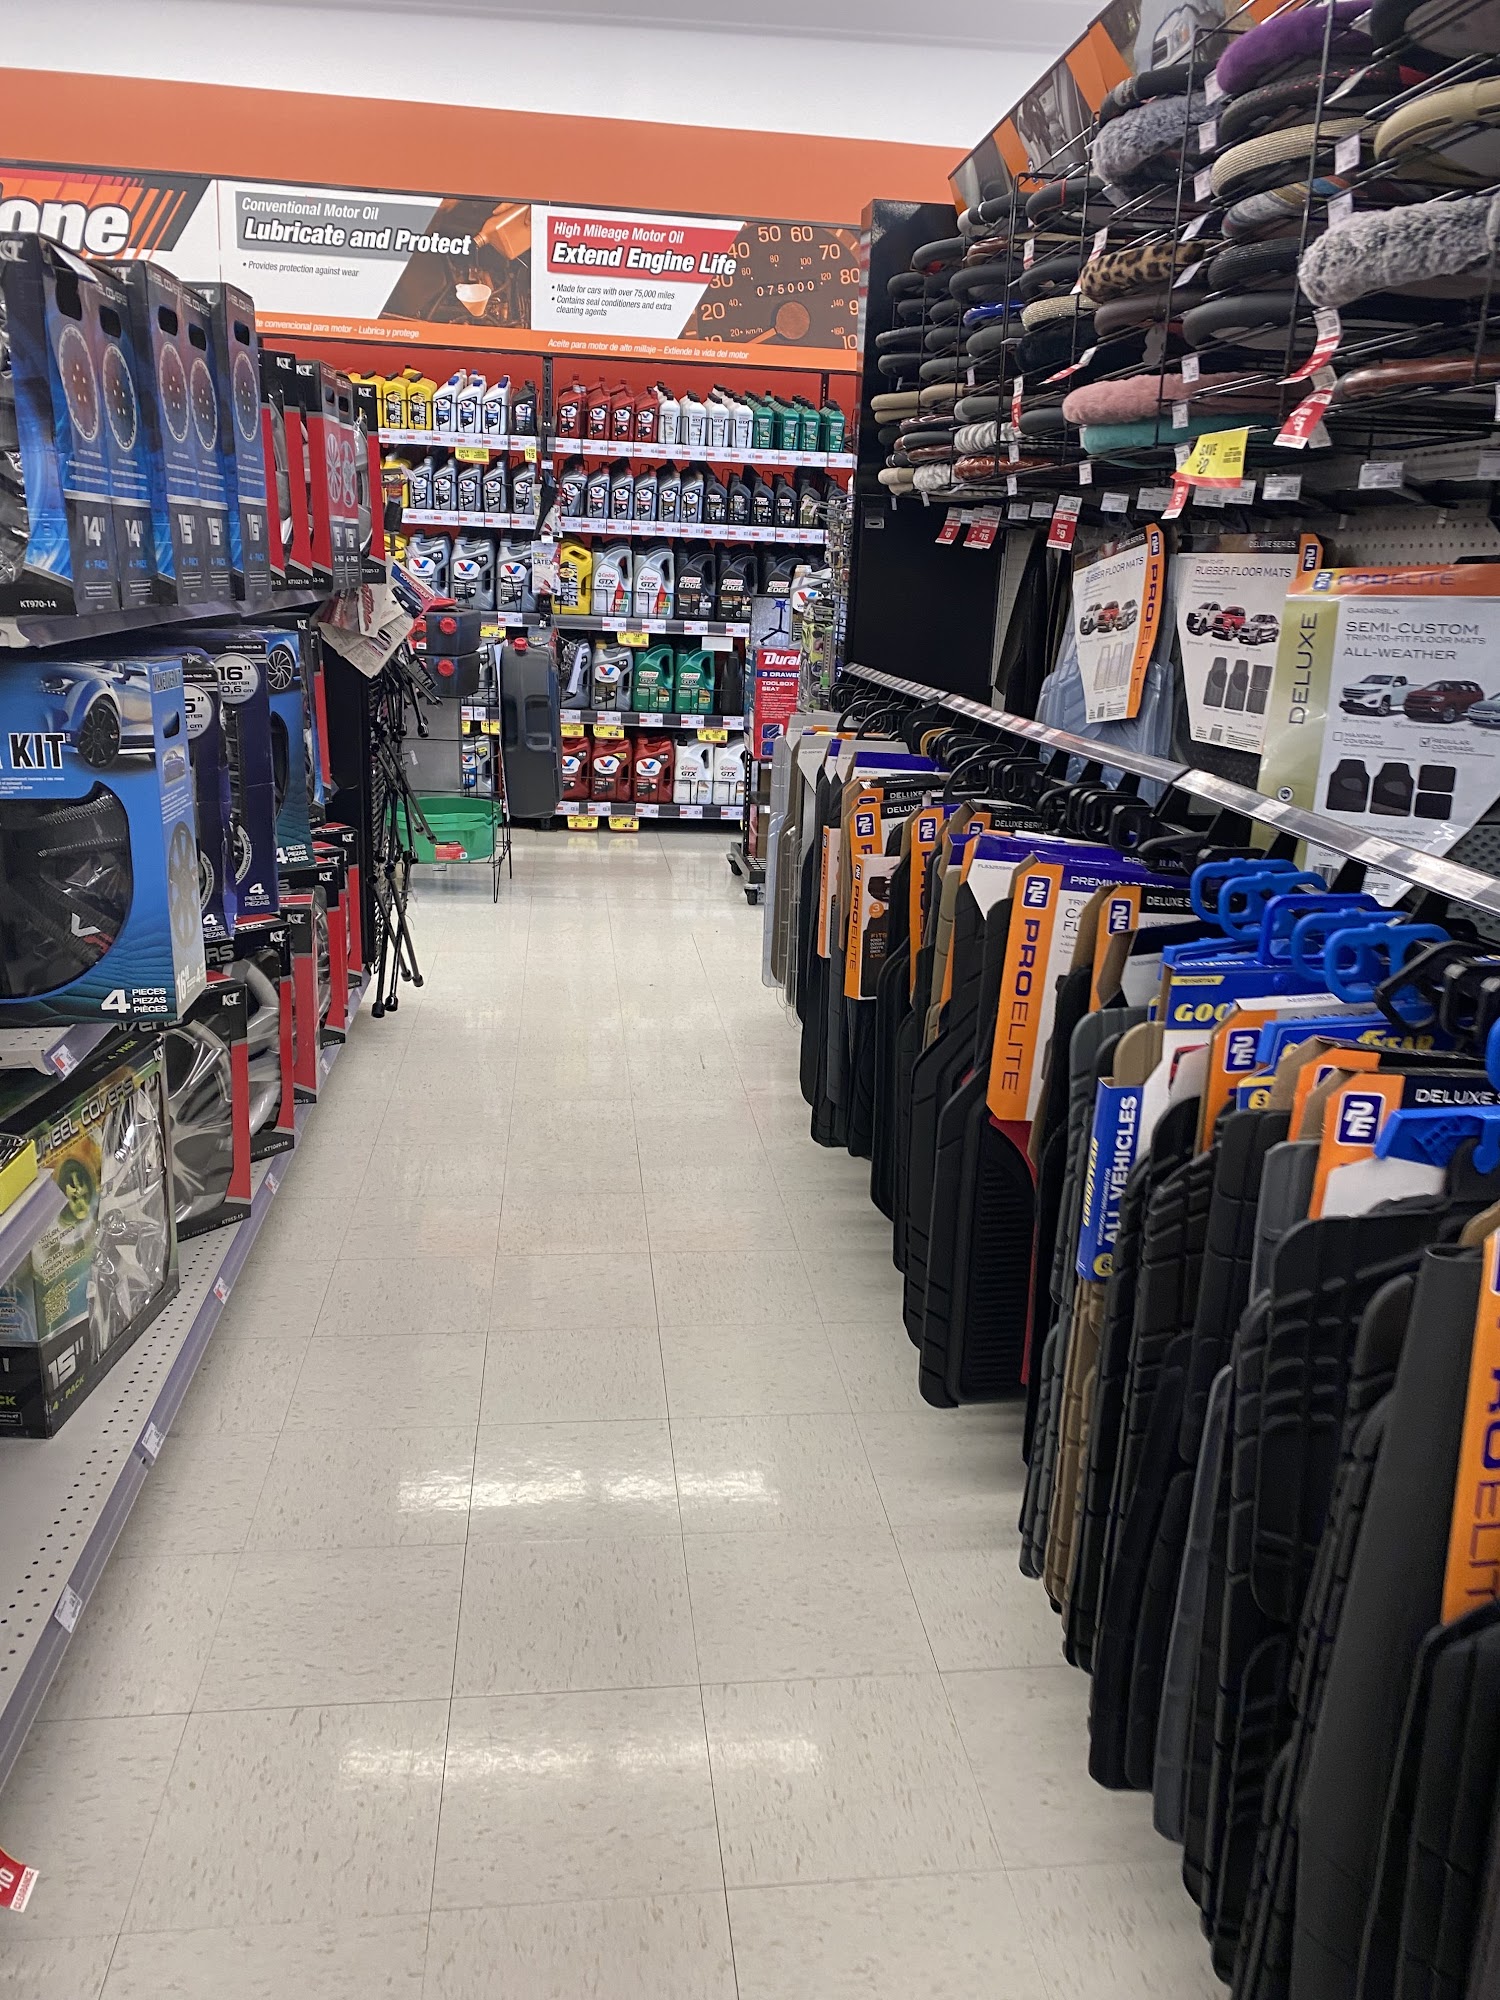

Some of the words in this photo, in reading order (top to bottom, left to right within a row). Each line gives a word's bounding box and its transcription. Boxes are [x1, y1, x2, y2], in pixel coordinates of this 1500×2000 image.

[242, 197, 320, 216] Conventional
[323, 204, 360, 218] Motor
[362, 207, 379, 220] Oil
[243, 218, 345, 246] Lubricate
[349, 228, 391, 249] and
[395, 229, 472, 255] Protect
[554, 222, 582, 238] High
[583, 224, 629, 242] Mileage
[632, 229, 666, 243] Motor
[668, 230, 684, 244] Oil
[758, 225, 781, 242] 50
[790, 226, 813, 242] 60
[552, 242, 621, 267] Extend
[626, 246, 694, 274] Engine
[698, 253, 737, 275] Life
[727, 242, 750, 259] 40
[819, 244, 841, 260] 70
[769, 255, 779, 263] 80
[800, 257, 812, 265] 100
[248, 261, 277, 272] Provides
[279, 263, 314, 275] protection
[315, 265, 340, 276] against
[342, 269, 359, 277] wear
[821, 273, 832, 281] 120
[840, 268, 860, 285] 80
[556, 284, 575, 293] Made
[576, 285, 586, 293] for
[587, 287, 602, 295] cars
[603, 287, 617, 295] with
[634, 289, 656, 299] 75,000
[657, 291, 675, 300] miles
[556, 295, 585, 305] Contains
[586, 297, 600, 306] seal
[601, 298, 641, 309] conditioners
[642, 301, 654, 309] and
[655, 302, 672, 311] extra
[556, 305, 584, 316] cleaning
[585, 308, 607, 317] agents
[701, 302, 725, 320] 20
[729, 299, 738, 307] 40
[833, 299, 844, 307] 140
[849, 300, 859, 316] 9
[264, 319, 312, 332] convencional
[313, 323, 329, 333] para
[331, 324, 352, 333] motor
[359, 326, 384, 337] Lubrica
[393, 328, 420, 339] protege
[730, 329, 740, 337] 20
[745, 327, 763, 335] km/h
[548, 338, 570, 348] Aceite
[570, 341, 587, 350] para
[588, 342, 608, 350] motor
[610, 343, 618, 351] de
[619, 344, 632, 352] alto
[633, 344, 656, 355] millaje
[663, 346, 692, 356] Extiende
[693, 347, 700, 356] la
[702, 349, 715, 357] vida
[716, 350, 728, 358] del
[729, 352, 749, 360] motor
[83, 515, 105, 547] 14"
[125, 519, 143, 548] 14"
[1056, 529, 1065, 539] $9
[1105, 563, 1126, 576] FLOOR
[1126, 557, 1144, 569] MATS
[1195, 566, 1231, 576] RUBBER
[1231, 567, 1262, 576] FLOOR
[1265, 568, 1291, 578] MATS
[1337, 572, 1457, 586] PROELITE
[20, 600, 56, 608] KT970-14
[1132, 564, 1159, 697] PROELITE
[1345, 621, 1479, 636] SEMI-CUSTOM
[1345, 633, 1412, 643] TRIM-TO-FIT
[1413, 635, 1453, 644] FLOOR
[1454, 637, 1486, 645] MATS
[763, 652, 801, 665] Dural
[1343, 647, 1456, 660] ALL-WEATHER
[1288, 612, 1318, 724] DELUXE
[9, 732, 66, 769] KIT
[994, 820, 1022, 829] DELUXE
[249, 883, 265, 895] 4
[873, 903, 881, 912] 3
[1146, 896, 1183, 908] DELUXE
[203, 913, 218, 926] 4
[850, 885, 861, 971] PROELITE
[132, 988, 167, 996] PIECES
[133, 996, 166, 1004] PIEZAS
[101, 989, 131, 1014] 4
[133, 1004, 168, 1013] PIÈCES
[1002, 919, 1041, 1091] PROELITE
[81, 1075, 134, 1126] COVERS
[1415, 1089, 1494, 1105] DELUXE
[1109, 1095, 1138, 1201] VEHICLES
[48, 1335, 84, 1391] 15"
[65, 1374, 85, 1399] PACK
[13, 1870, 34, 1909] CLEARANCE
